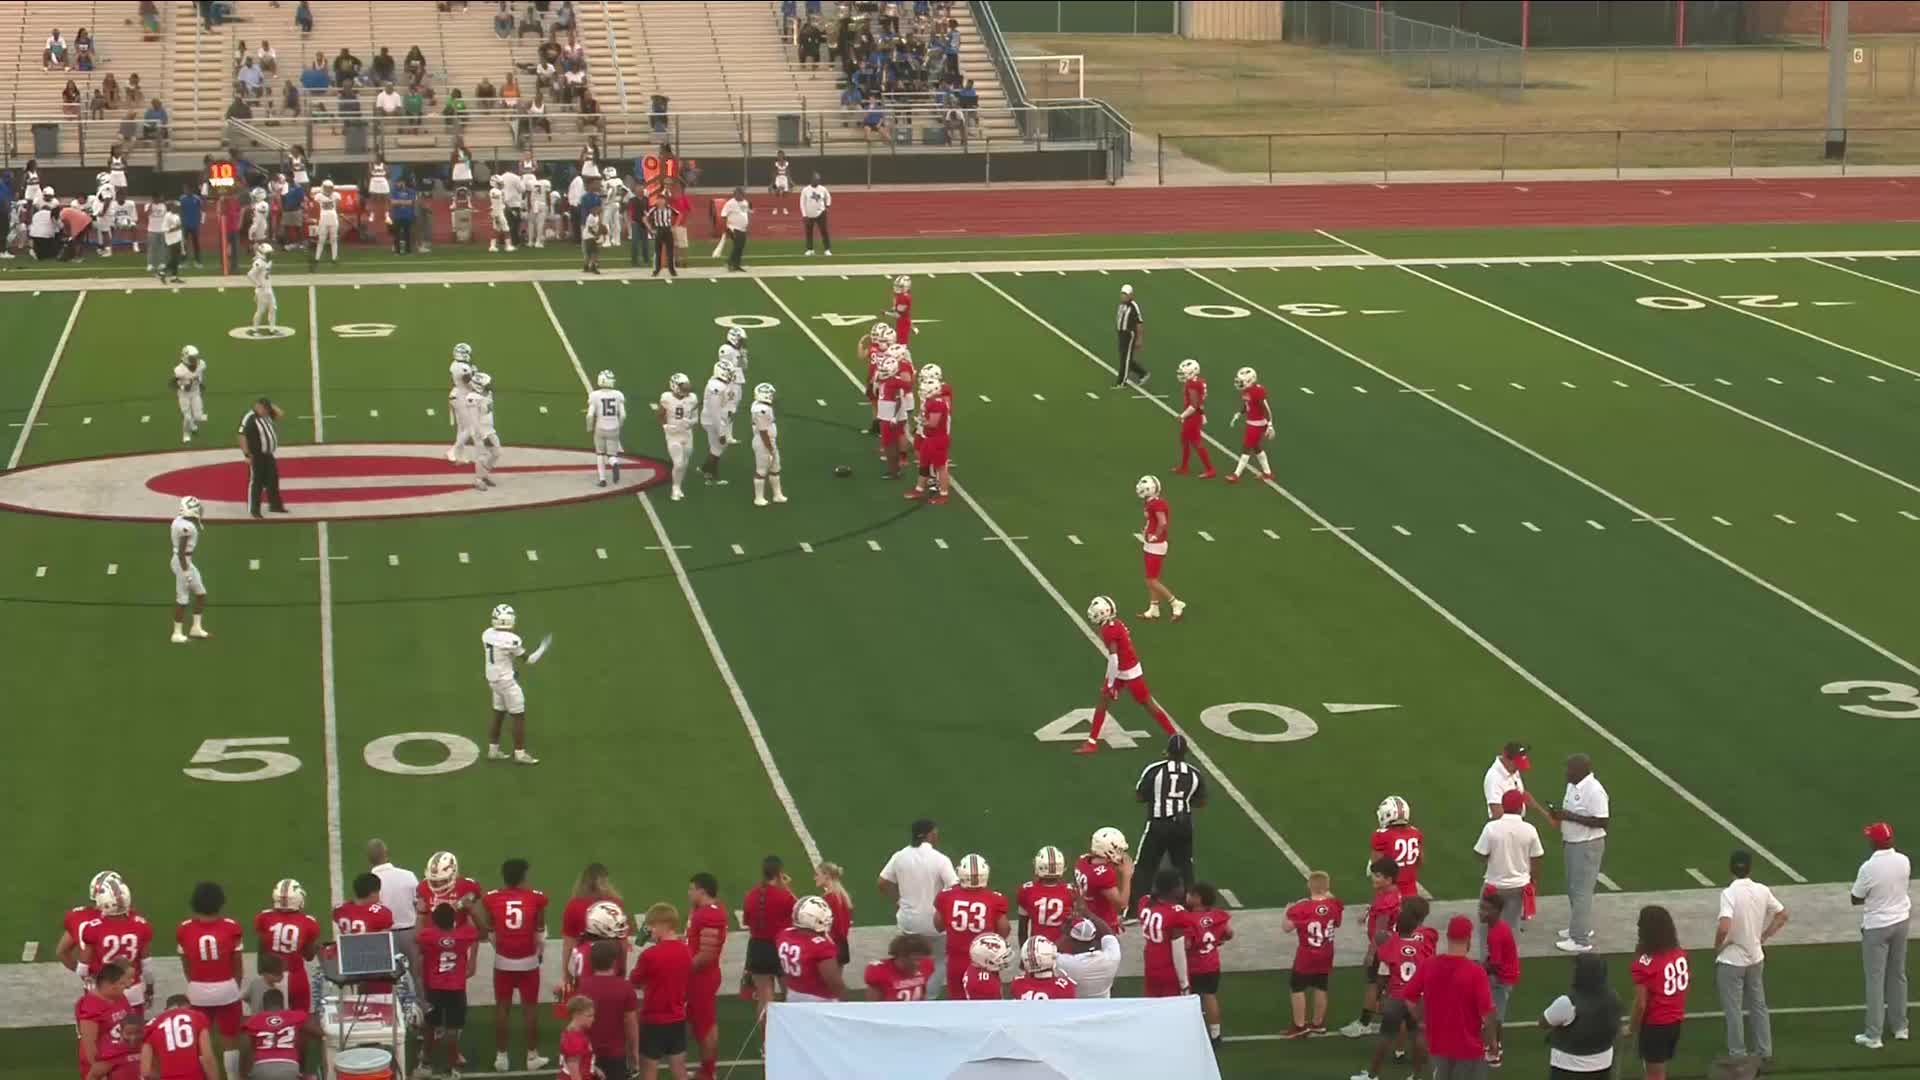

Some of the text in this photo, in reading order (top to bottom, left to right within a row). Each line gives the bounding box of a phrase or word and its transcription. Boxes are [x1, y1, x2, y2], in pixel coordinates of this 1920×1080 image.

[601, 398, 616, 416] 15
[675, 407, 684, 419] 9
[1168, 774, 1185, 798] L
[1394, 838, 1419, 866] 26
[505, 901, 522, 929] 5
[951, 900, 987, 933] 53
[1034, 897, 1064, 927] 12
[1139, 909, 1163, 943] 20
[103, 933, 138, 964] 23
[269, 922, 300, 953] 19
[978, 971, 990, 981] 10
[1664, 956, 1688, 996] 88
[158, 1014, 193, 1051] 16
[256, 1026, 296, 1049] 32
